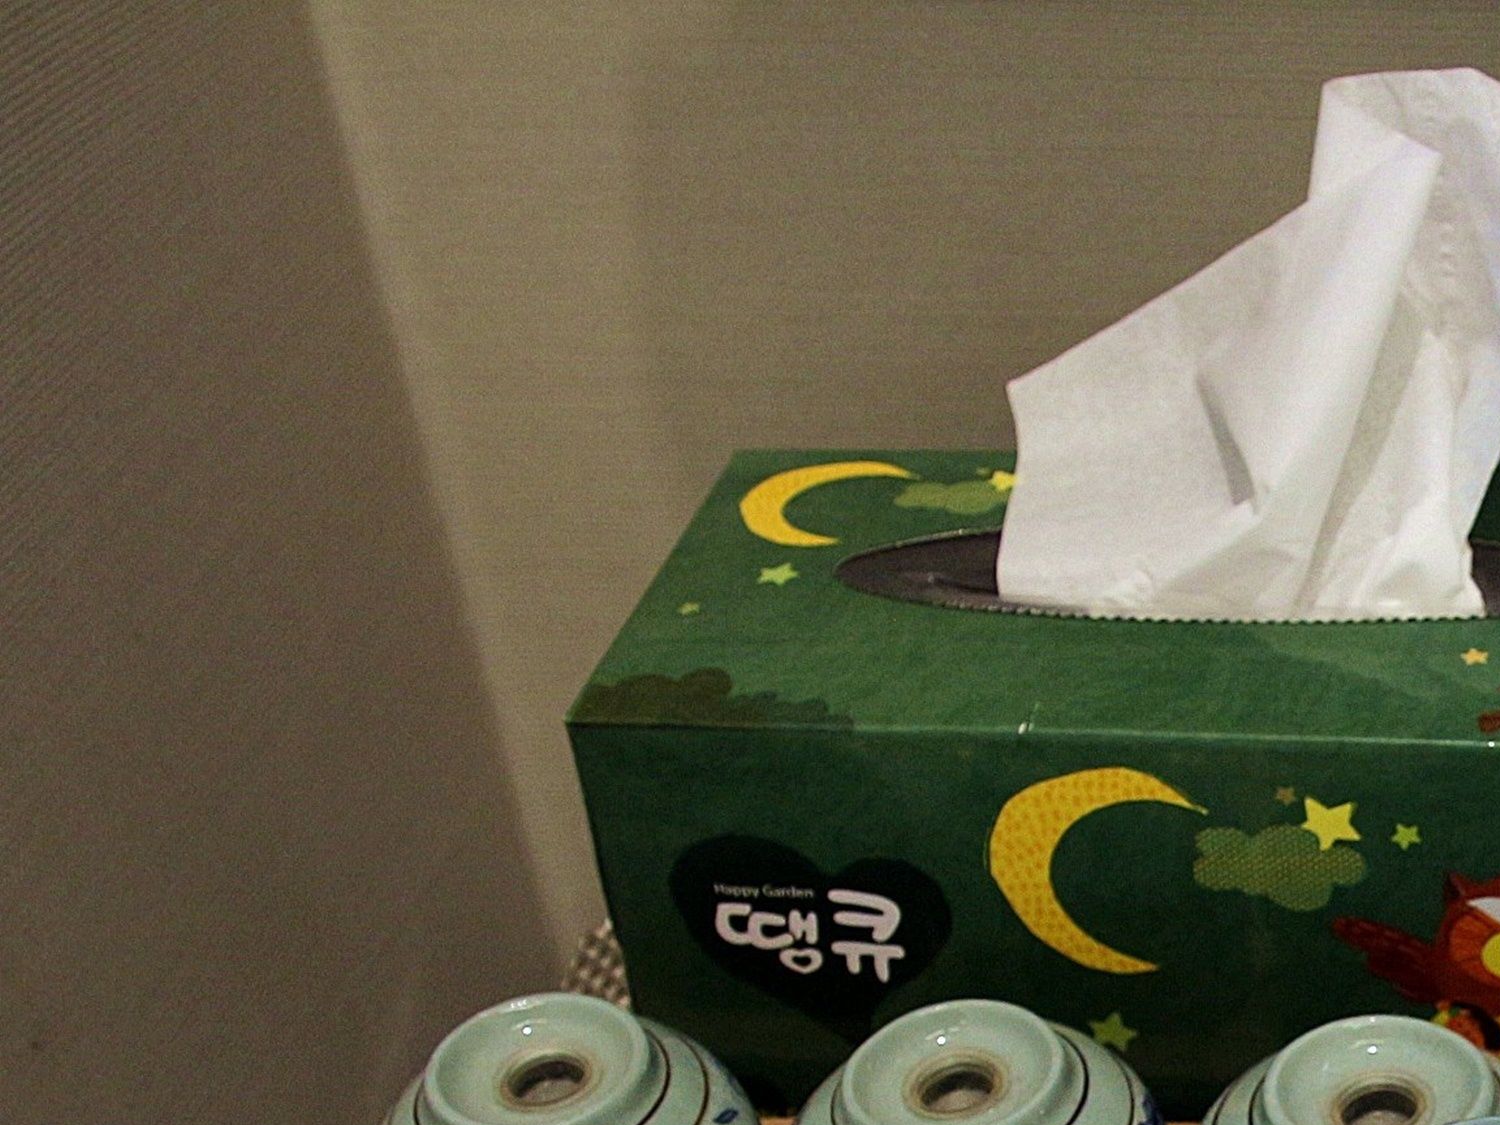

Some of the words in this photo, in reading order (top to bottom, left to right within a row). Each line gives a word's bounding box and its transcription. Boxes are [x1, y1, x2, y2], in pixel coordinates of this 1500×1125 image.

[713, 883, 759, 898] Happy
[762, 884, 815, 898] Garden
[715, 889, 905, 983] 땡큐
